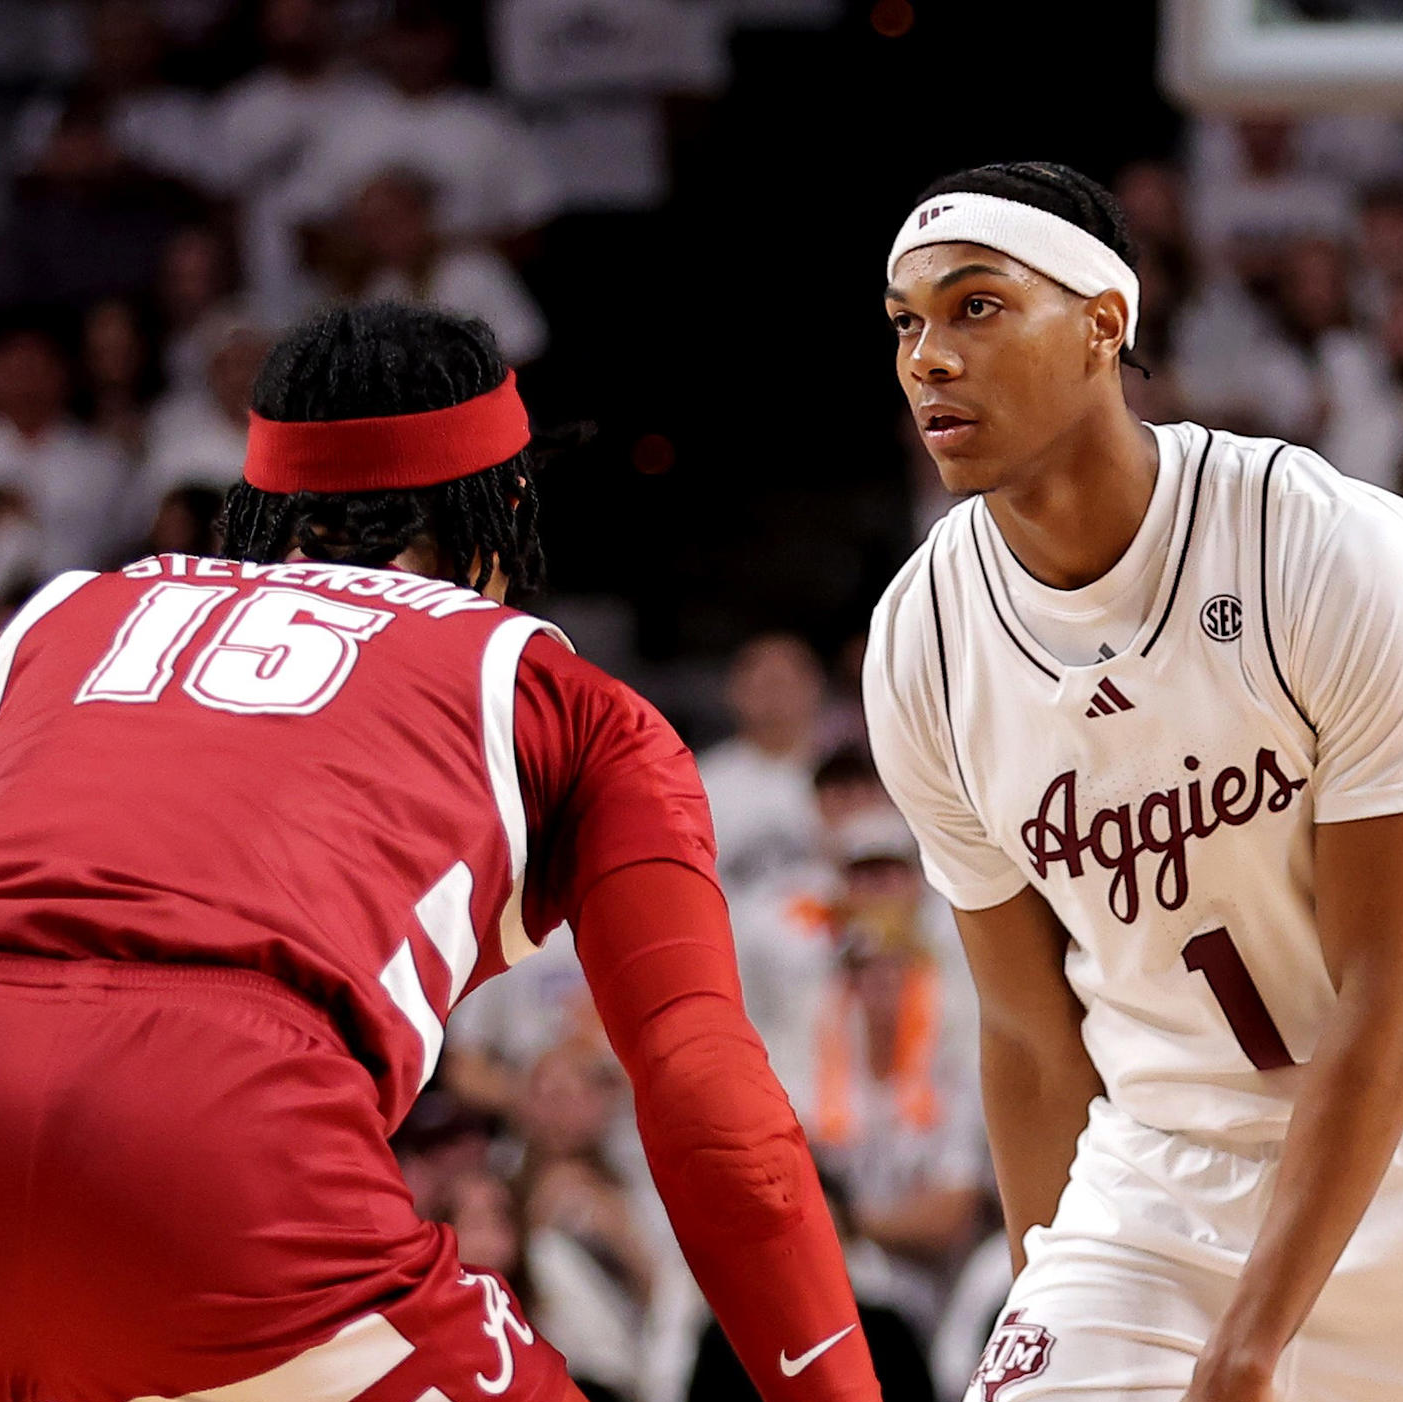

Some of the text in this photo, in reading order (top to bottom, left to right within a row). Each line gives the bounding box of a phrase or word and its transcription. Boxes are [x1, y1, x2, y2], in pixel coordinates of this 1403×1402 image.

[74, 580, 396, 716] 15
[122, 552, 500, 619] STEVENSON
[1206, 599, 1242, 637] SEC
[1021, 747, 1308, 925] Aggies
[1180, 925, 1299, 1072] 1
